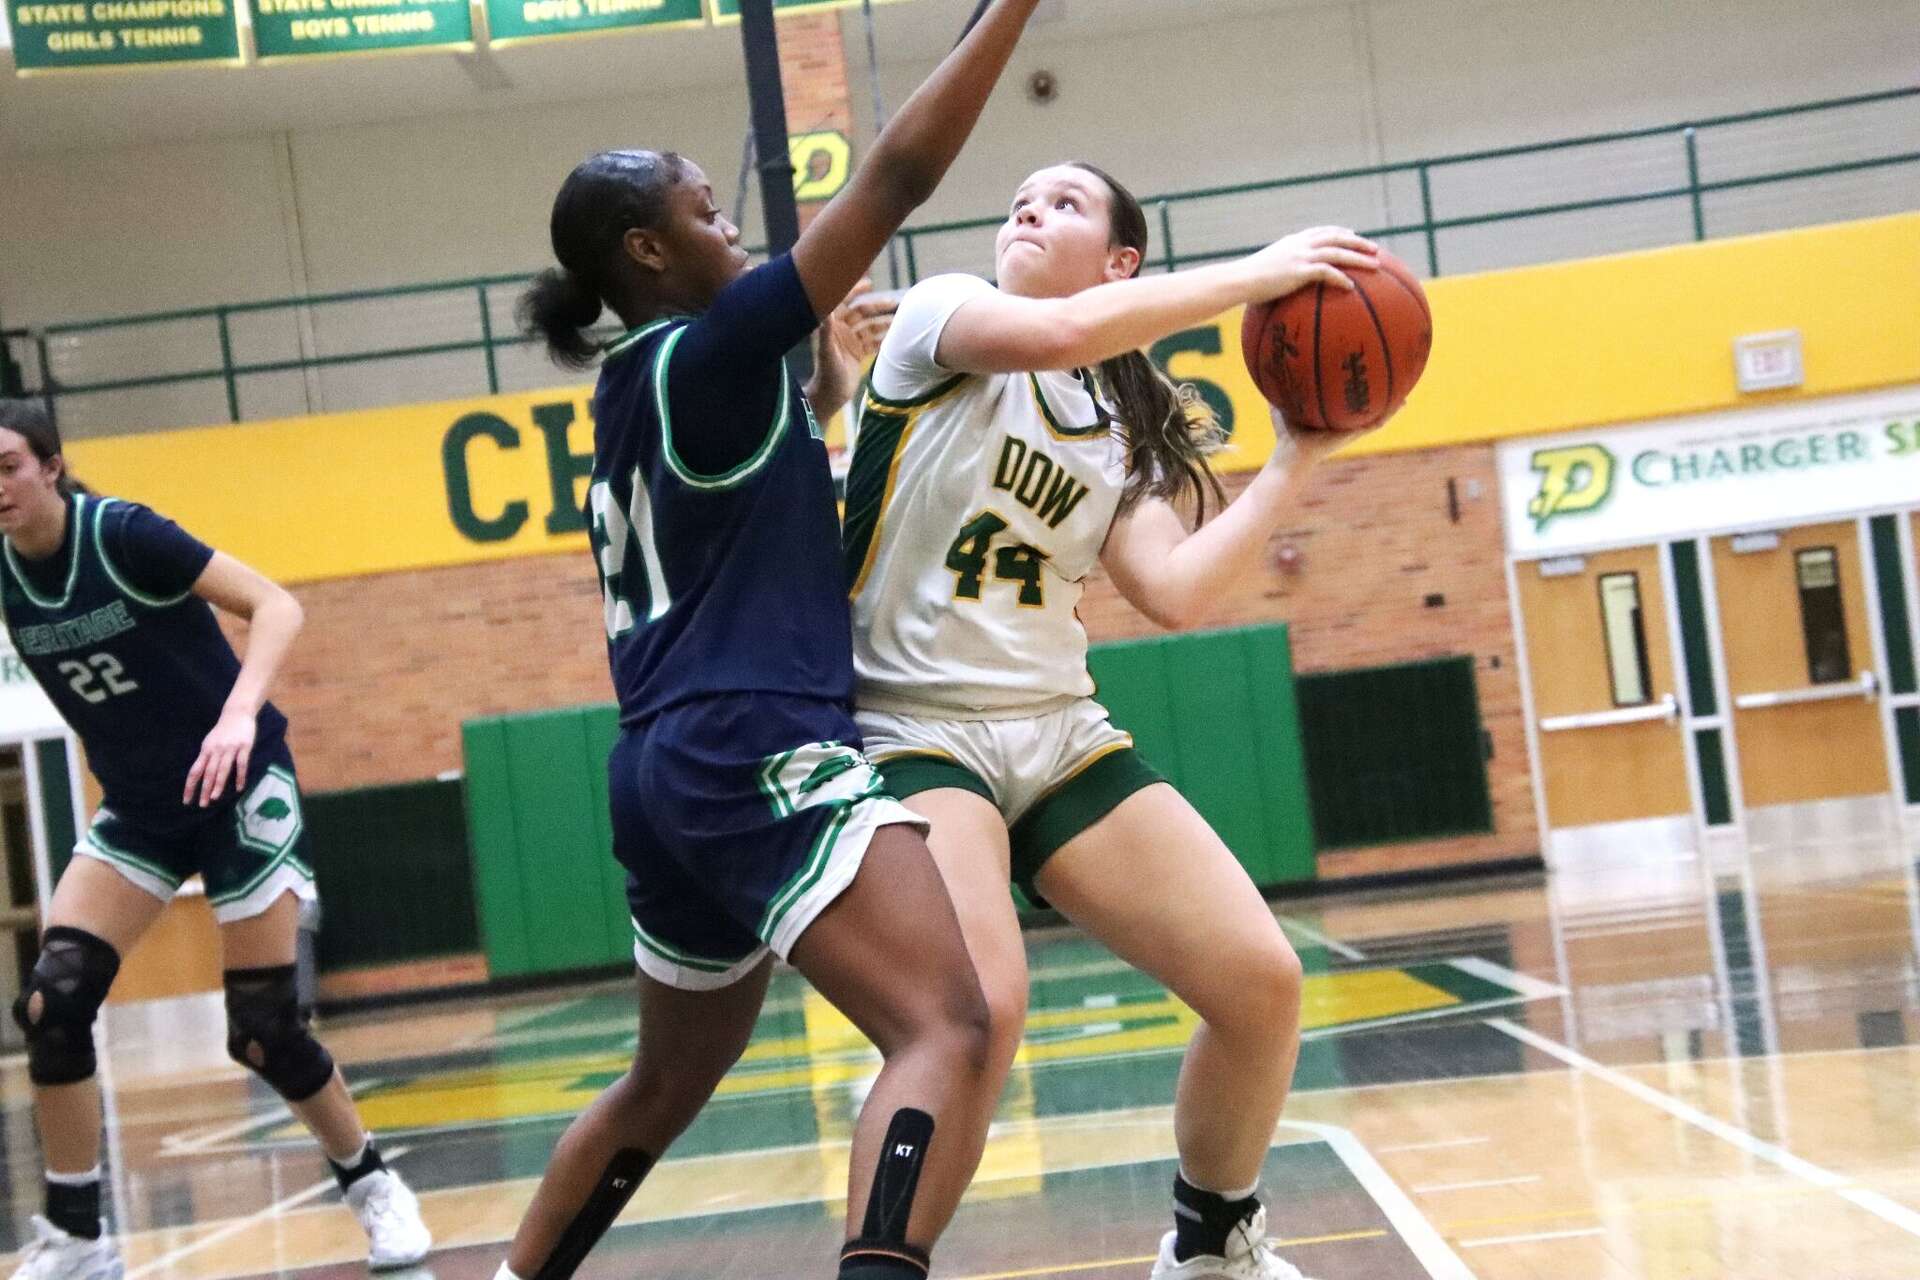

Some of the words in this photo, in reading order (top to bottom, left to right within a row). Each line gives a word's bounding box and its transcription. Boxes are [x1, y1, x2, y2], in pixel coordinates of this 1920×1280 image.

[17, 4, 87, 25] STATE
[47, 31, 114, 52] GIRLS
[118, 26, 203, 48] TENNIS
[290, 17, 350, 40] BOYS
[1631, 430, 1867, 488] CHARGER
[994, 435, 1090, 530] DOW
[945, 510, 1050, 608] 44
[58, 652, 138, 704] 22
[895, 1143, 914, 1158] KT
[611, 1177, 628, 1190] KT
